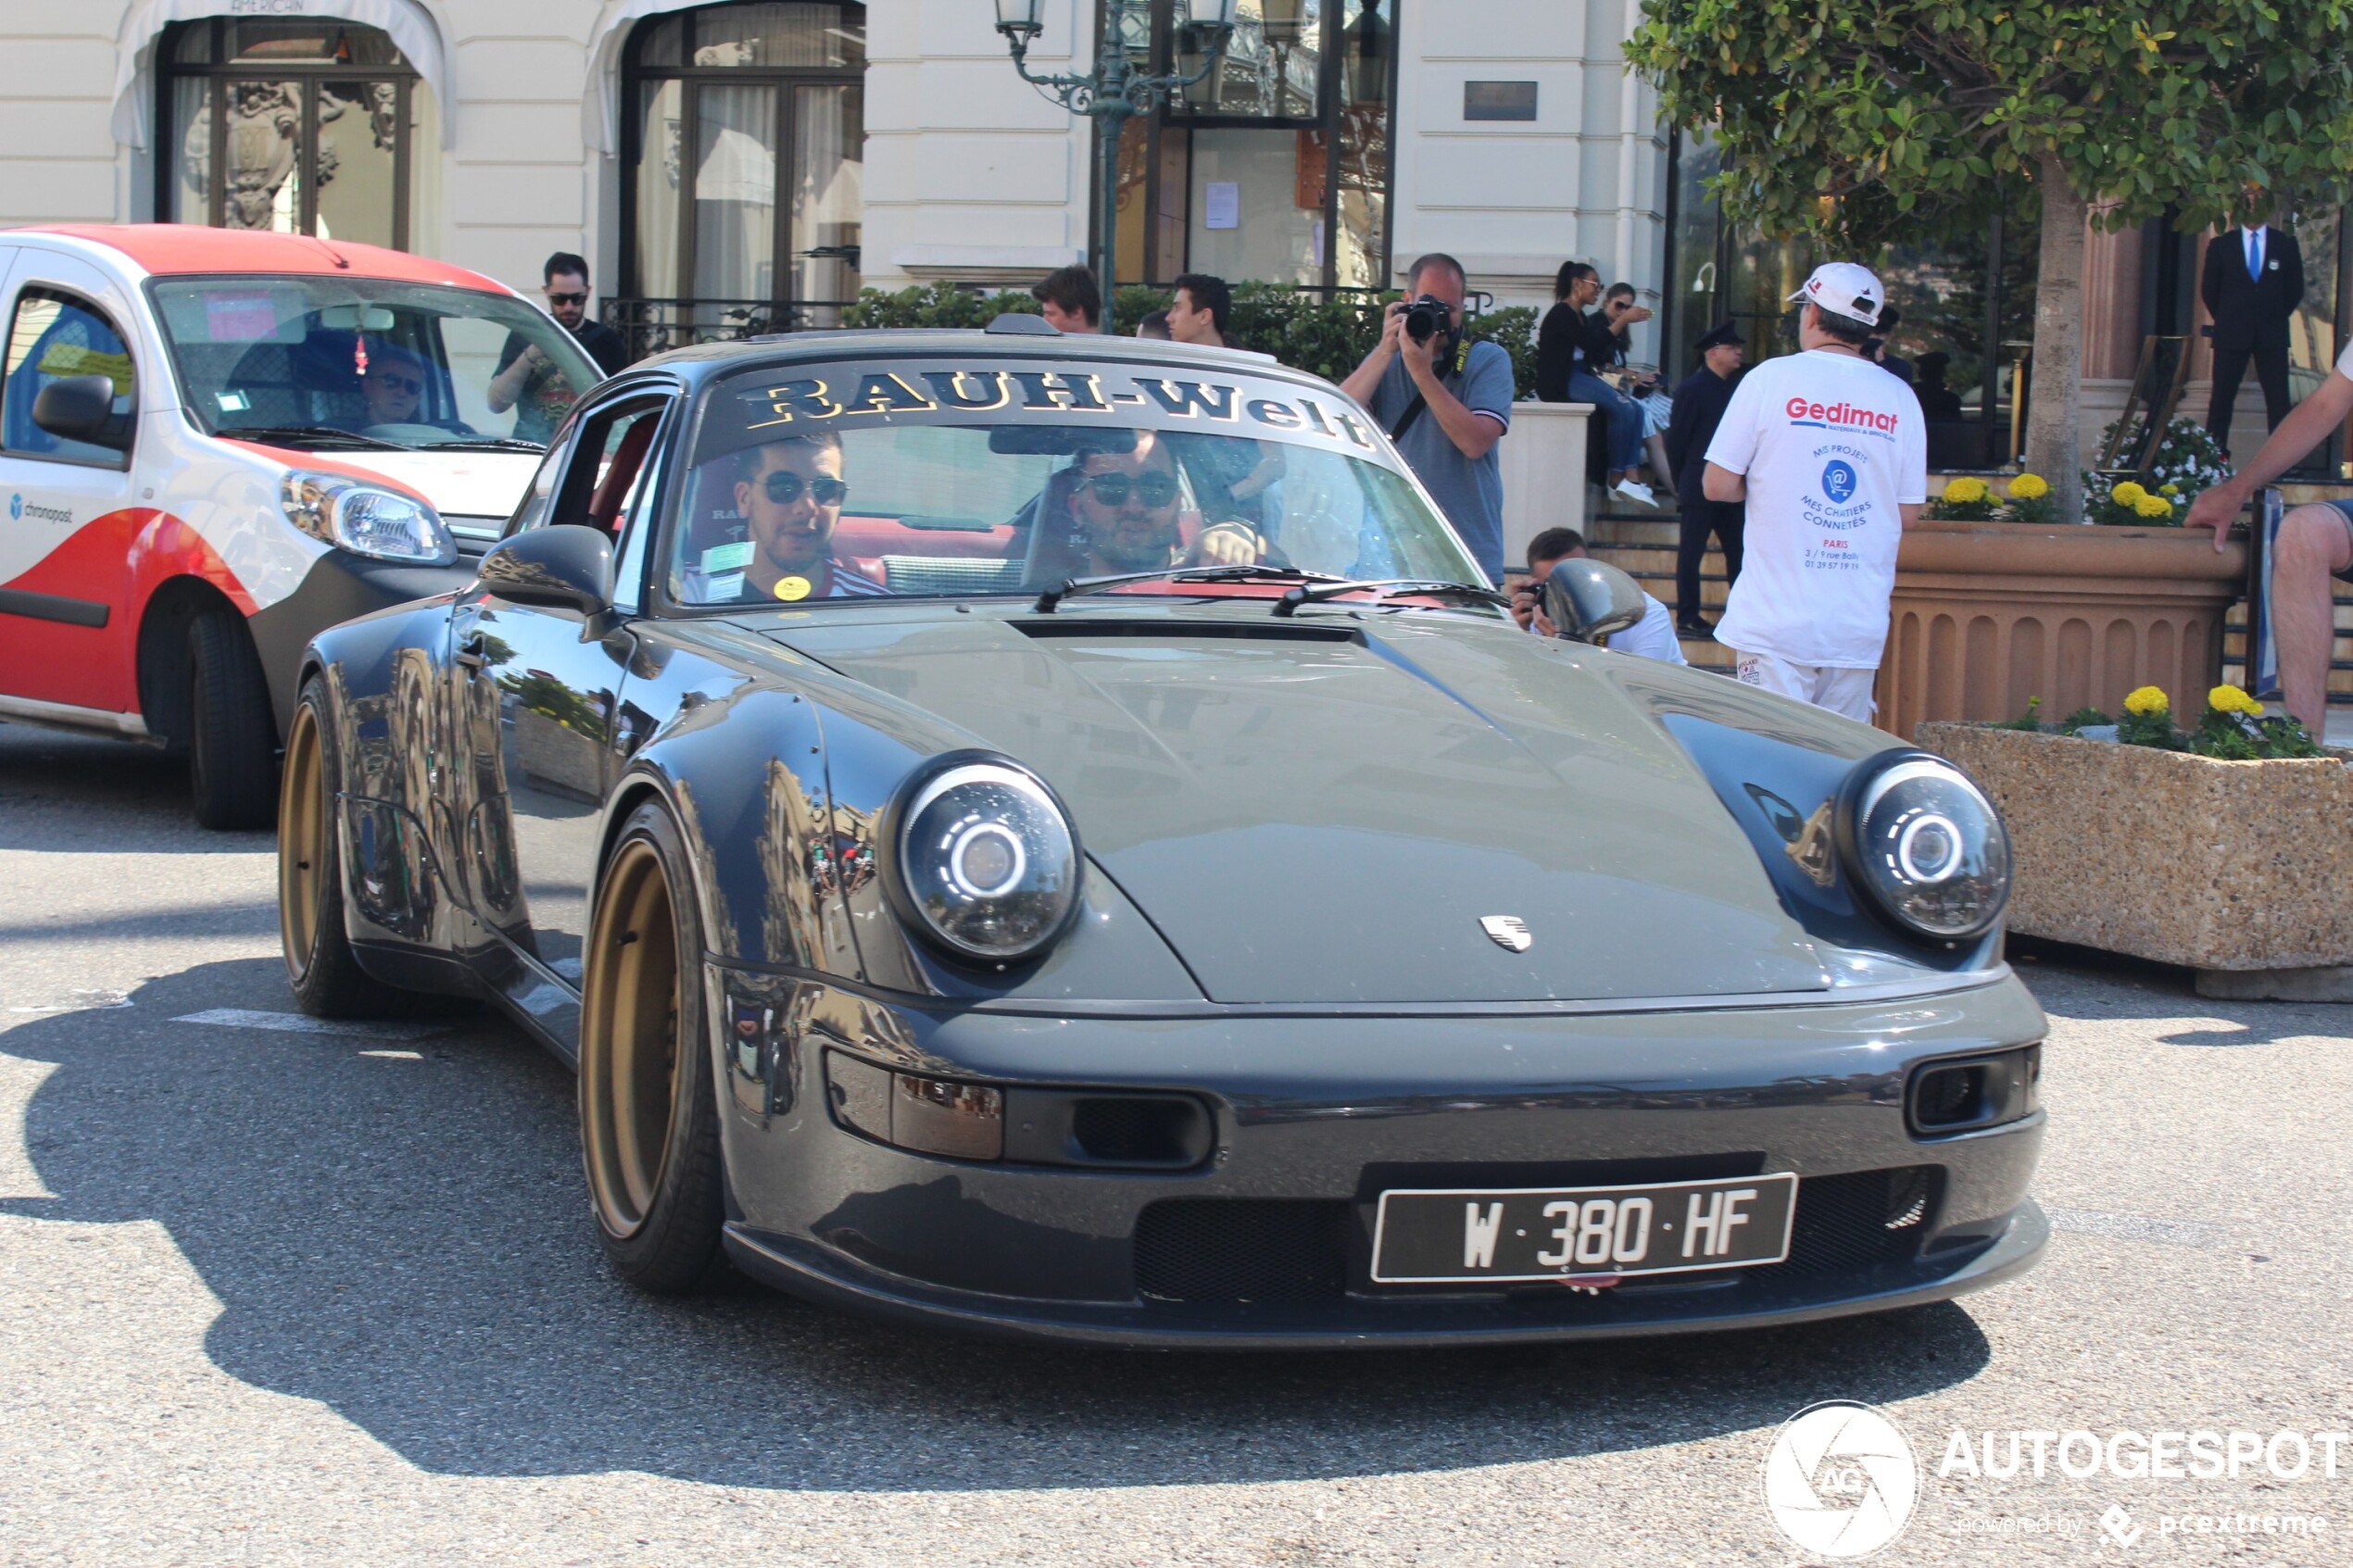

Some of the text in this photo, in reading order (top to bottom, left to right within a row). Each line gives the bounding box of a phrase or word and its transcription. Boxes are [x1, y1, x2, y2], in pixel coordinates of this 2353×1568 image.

[737, 371, 1376, 452] RAUH-Welt
[1786, 397, 1898, 434] Gedimat
[1801, 495, 1822, 511] MES
[1823, 539, 1848, 548] PARIS
[1805, 559, 1814, 568] 01
[1829, 561, 1838, 570] 57
[1464, 1189, 1757, 1268] W 380 HF
